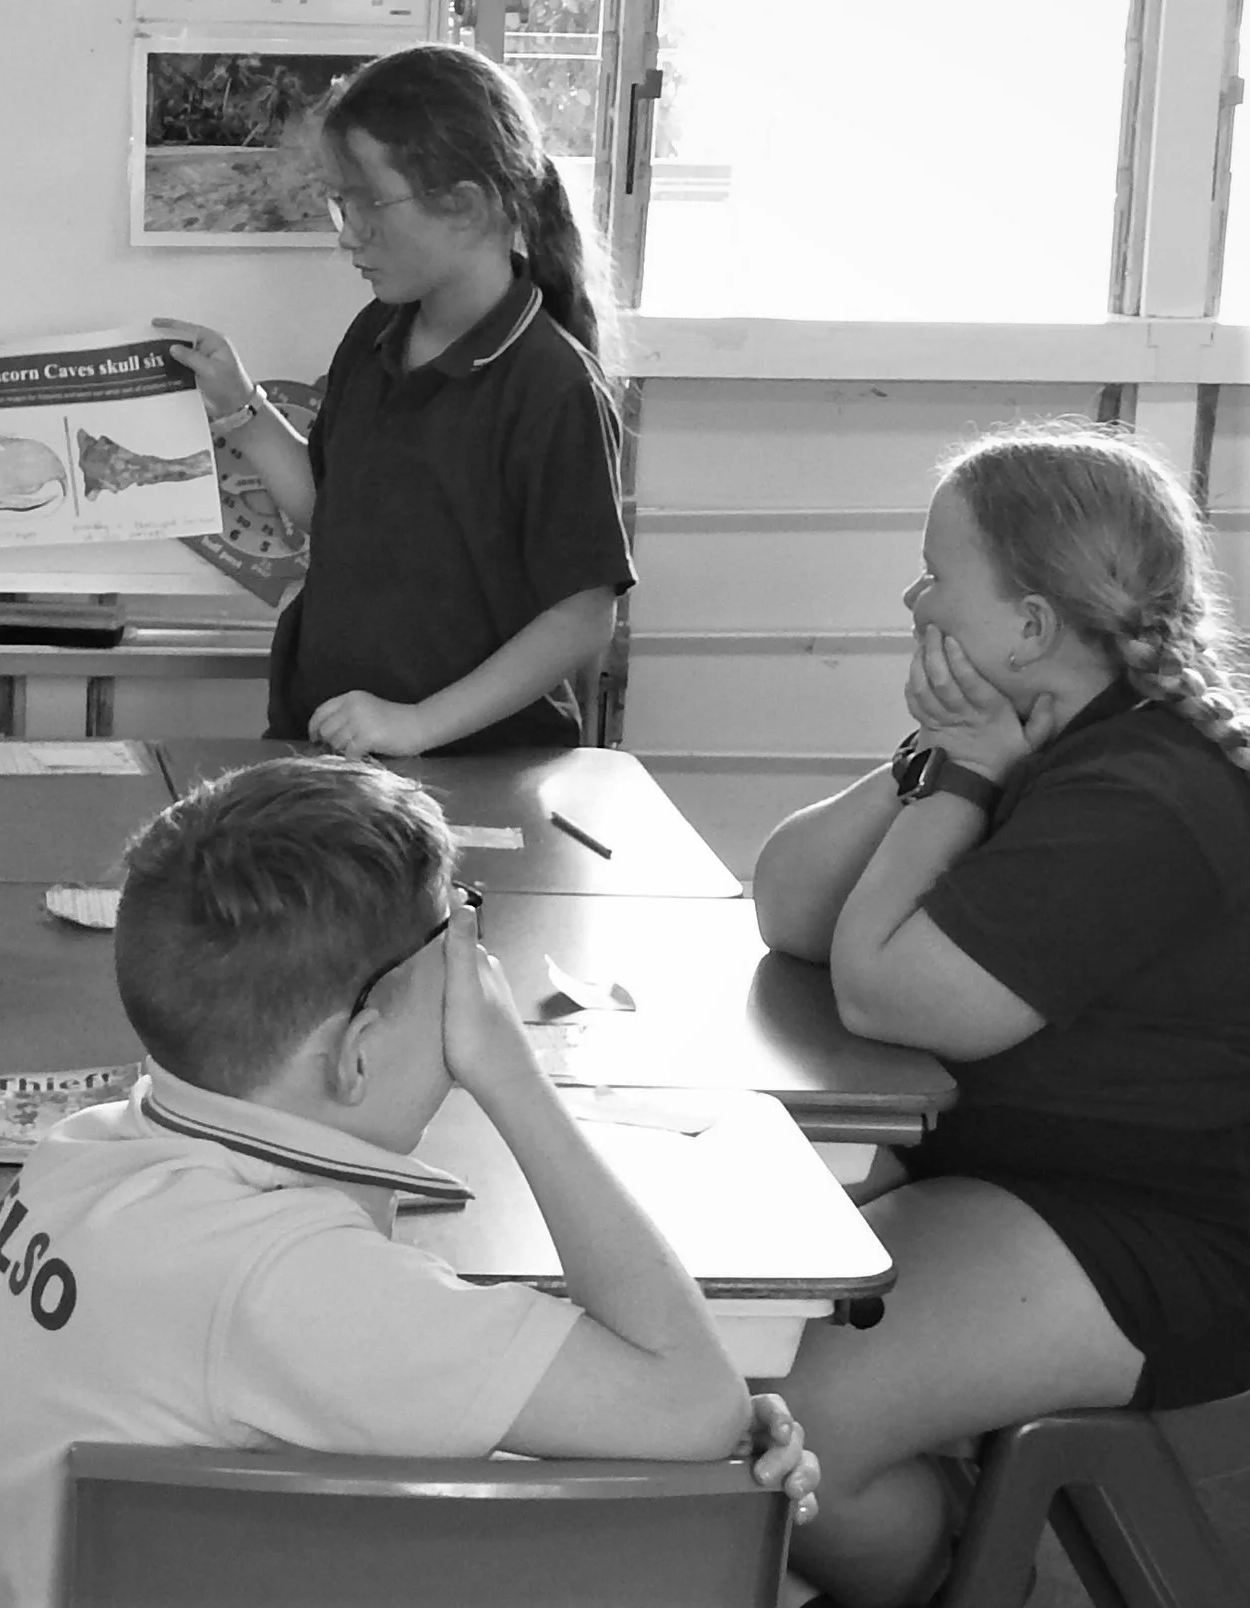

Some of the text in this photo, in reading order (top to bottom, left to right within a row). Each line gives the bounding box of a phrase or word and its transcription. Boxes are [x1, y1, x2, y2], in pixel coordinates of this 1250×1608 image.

[43, 363, 96, 380] Caves
[98, 355, 140, 376] skull
[143, 352, 165, 370] six
